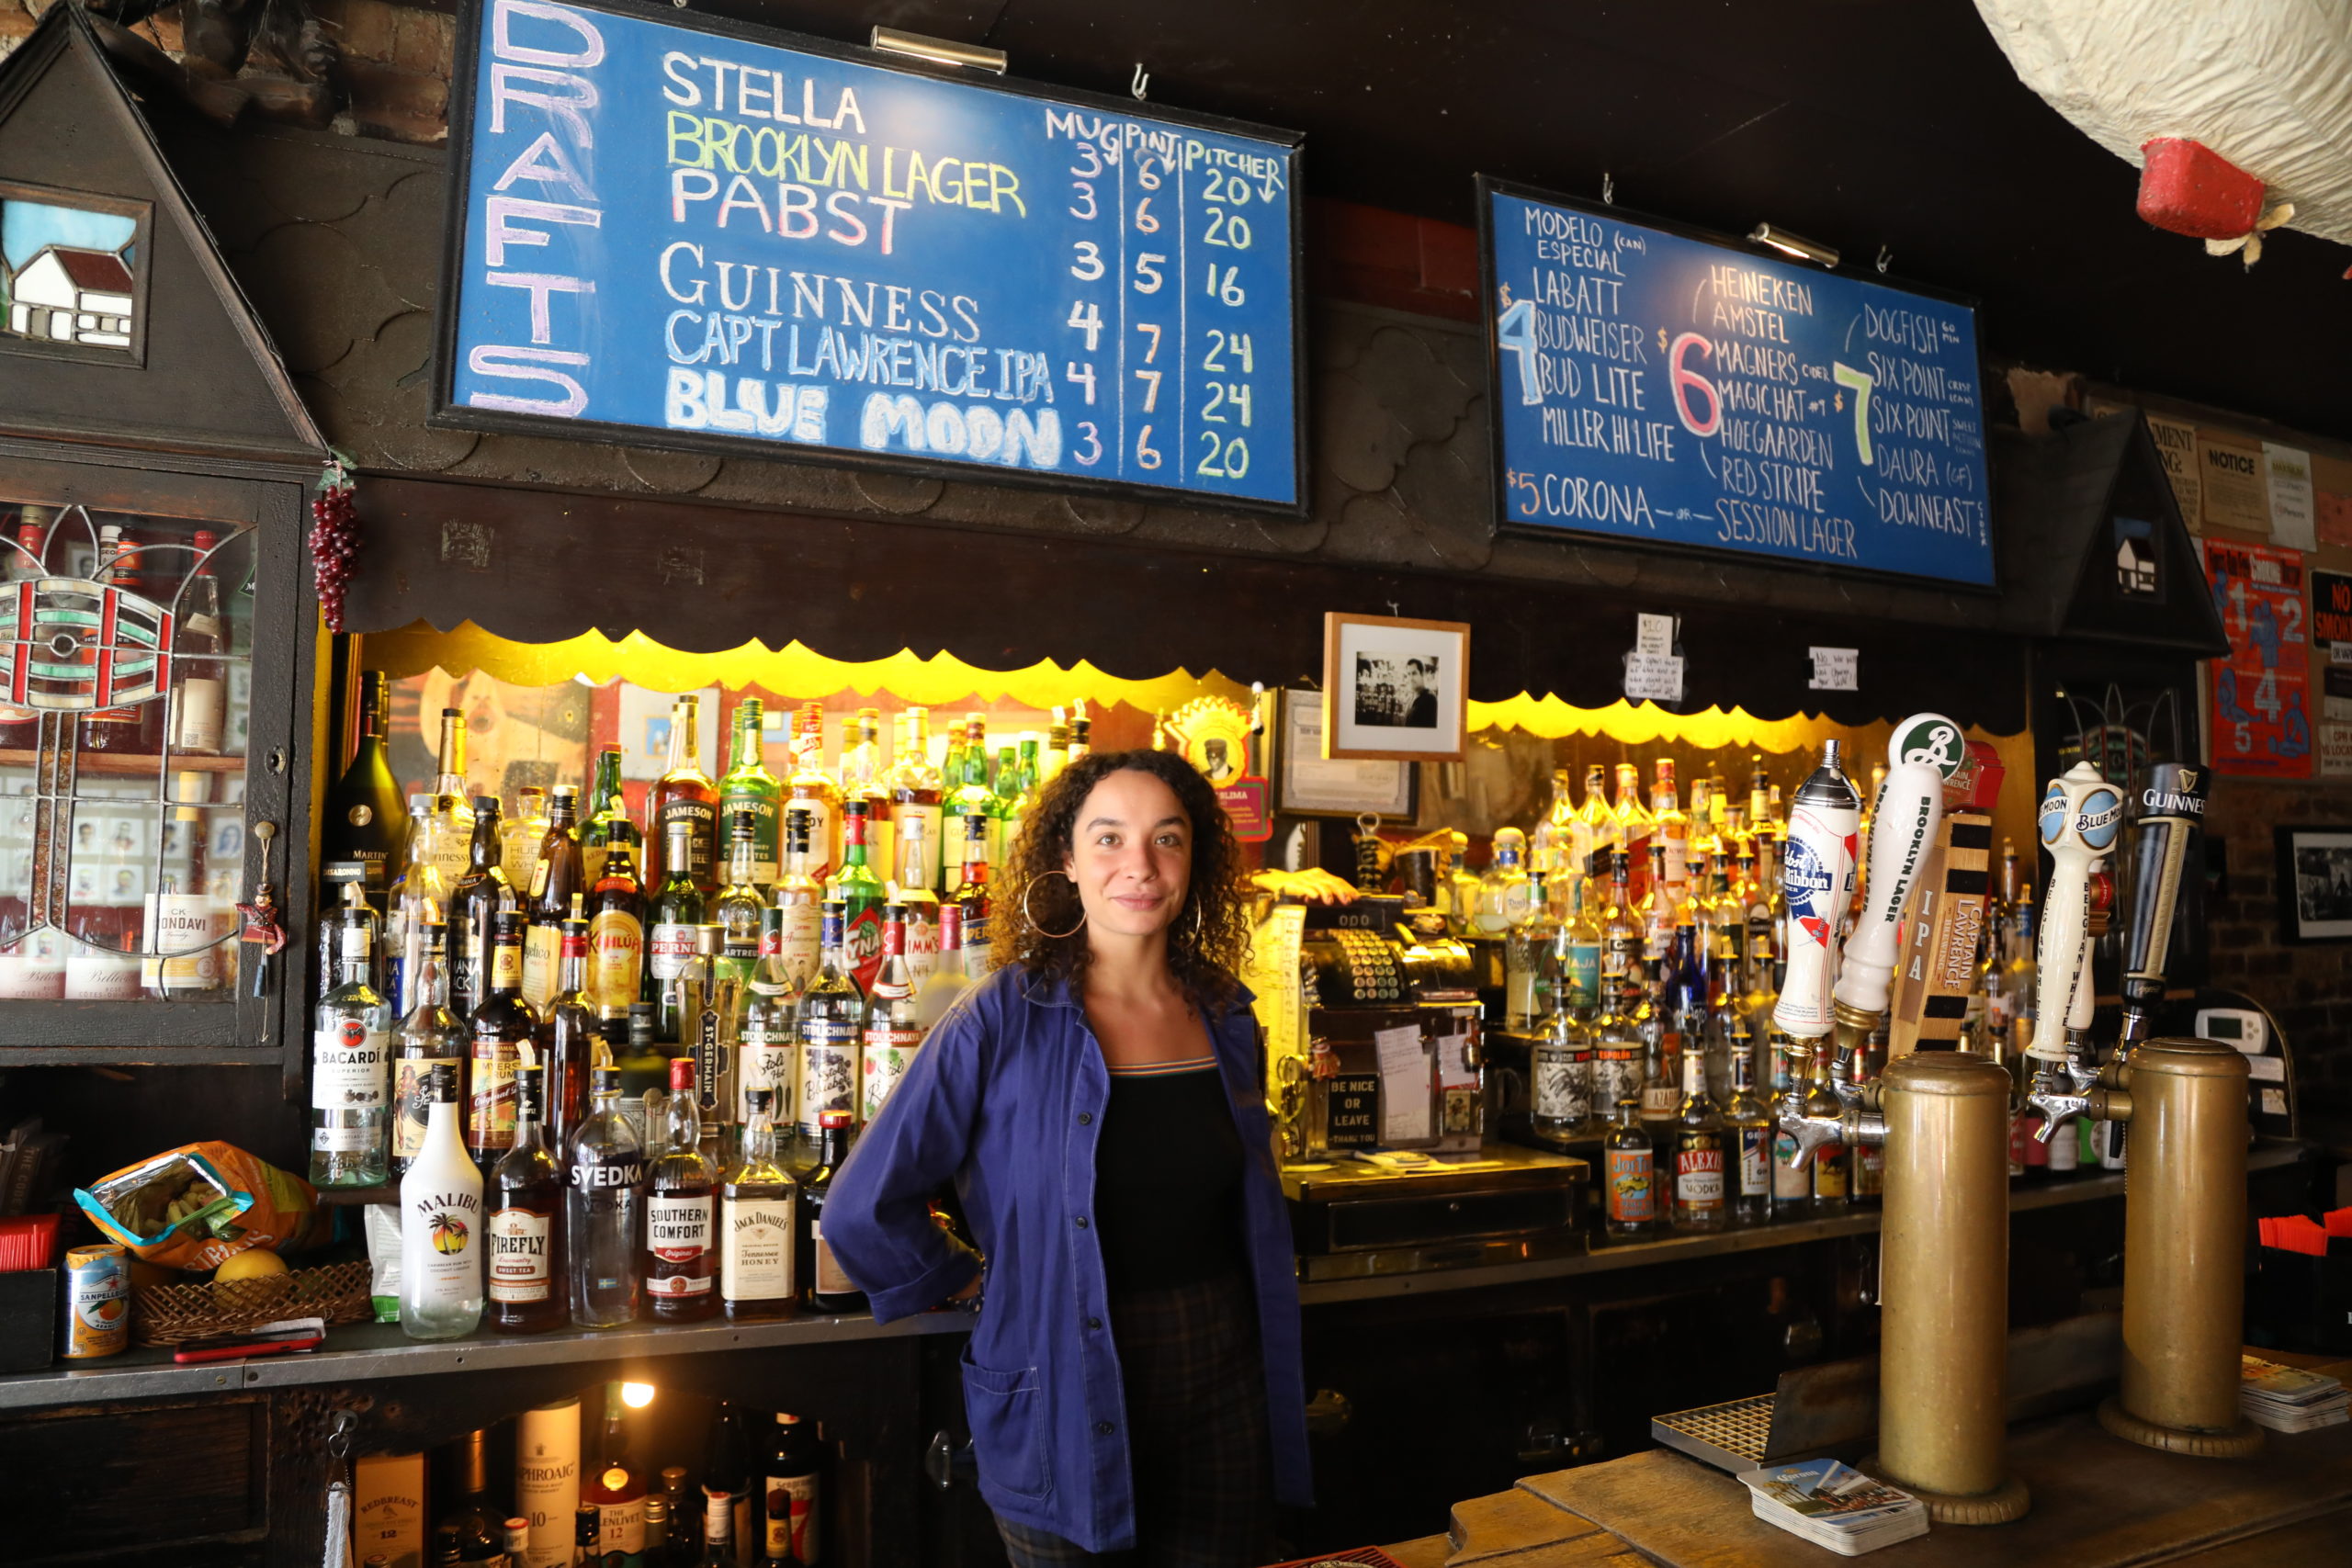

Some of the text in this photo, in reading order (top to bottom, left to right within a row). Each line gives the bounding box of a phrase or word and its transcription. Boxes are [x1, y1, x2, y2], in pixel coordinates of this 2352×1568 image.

[663, 51, 1250, 206] STELLA 3 6 20
[1046, 108, 1283, 189] MUG PINT PITCHER
[667, 110, 1251, 249] BROOKLYN LAGER 3 6 20
[469, 0, 605, 419] DRAFTS
[1525, 207, 1645, 255] MODELO (CAN)
[672, 168, 1245, 306] PABST 3 5 16
[1538, 240, 1626, 277] ESPECIAL
[660, 241, 1252, 373] GUINNESS 4 7 24
[1533, 267, 1623, 315] LABATT
[1711, 265, 1814, 316] HEINEKEN
[1535, 309, 1647, 365] BUDWEISER
[1713, 300, 1790, 344] AMSTEL
[1864, 303, 1939, 355] DOGFISH
[789, 325, 990, 398] LAWRENCE
[994, 348, 1055, 404] IPA
[1066, 363, 1095, 405] 4
[1136, 370, 1161, 412] 7
[1202, 382, 1250, 426] 24
[1539, 353, 1645, 411] BUD LITE
[1714, 339, 1830, 386] MAGNERS CIDER
[1867, 351, 1946, 402] SIX POINT
[1717, 378, 1770, 416] MAGIC
[1774, 389, 1806, 423] HAT
[1871, 396, 1951, 447] SIX POINT
[665, 367, 1250, 479] BLUE MOON 3 6 20
[1543, 406, 1611, 453] MILLER
[1635, 421, 1675, 461] LIFE
[1719, 415, 1834, 470] HOEGAARDEN
[1877, 444, 1939, 488] DAURA
[2209, 449, 2255, 475] NOTICE
[1723, 456, 1826, 514] RED STRIPE
[1544, 473, 1655, 529] CORONA
[1715, 497, 1797, 549] SESSION
[1803, 513, 1858, 559] LAGER
[1880, 488, 1975, 538] DOWNEAST
[2332, 583, 2351, 611] NO
[2282, 598, 2304, 642] 2
[2254, 668, 2282, 722] 4
[665, 806, 713, 821] JAMESON
[722, 802, 773, 818] JAMESON
[2076, 813, 2109, 831] BLUE
[1884, 796, 1931, 922] BROOKLYN LAGER
[162, 918, 206, 931] ONDAVI
[588, 927, 640, 953] KAHLÚA
[908, 937, 939, 954] IMM'S
[1944, 899, 1975, 989] LAWRENCE
[1960, 907, 1982, 980] CAPTAIN
[651, 942, 695, 953] PERN
[2036, 877, 2056, 1021] BELGIAN WHITE
[2062, 882, 2089, 1027] BELGIAN WHITE
[322, 1047, 379, 1064] BACARDÍ
[705, 1025, 715, 1093] ST-GERMAIN
[1331, 1080, 1375, 1092] BE NICE
[1345, 1099, 1361, 1110] OR
[1335, 1115, 1370, 1126] LEAVE
[1361, 1134, 1375, 1143] YOU
[571, 1164, 642, 1187] SVEDKA
[1686, 1184, 1721, 1194] VODKA
[417, 1192, 481, 1218] MALIBU
[651, 1209, 707, 1223] SOUTHERN
[734, 1212, 788, 1232] JACK DANIEL'S
[492, 1235, 545, 1257] FIREFLY
[654, 1224, 705, 1239] COMFORT
[665, 1249, 693, 1258] Original
[741, 1250, 779, 1258] Tennessee
[519, 1462, 575, 1483] PHROAIG
[361, 1495, 419, 1516] REDBREAST
[532, 1512, 546, 1528] 10
[600, 1513, 640, 1528] LENLIVET
[610, 1528, 623, 1539] 12
